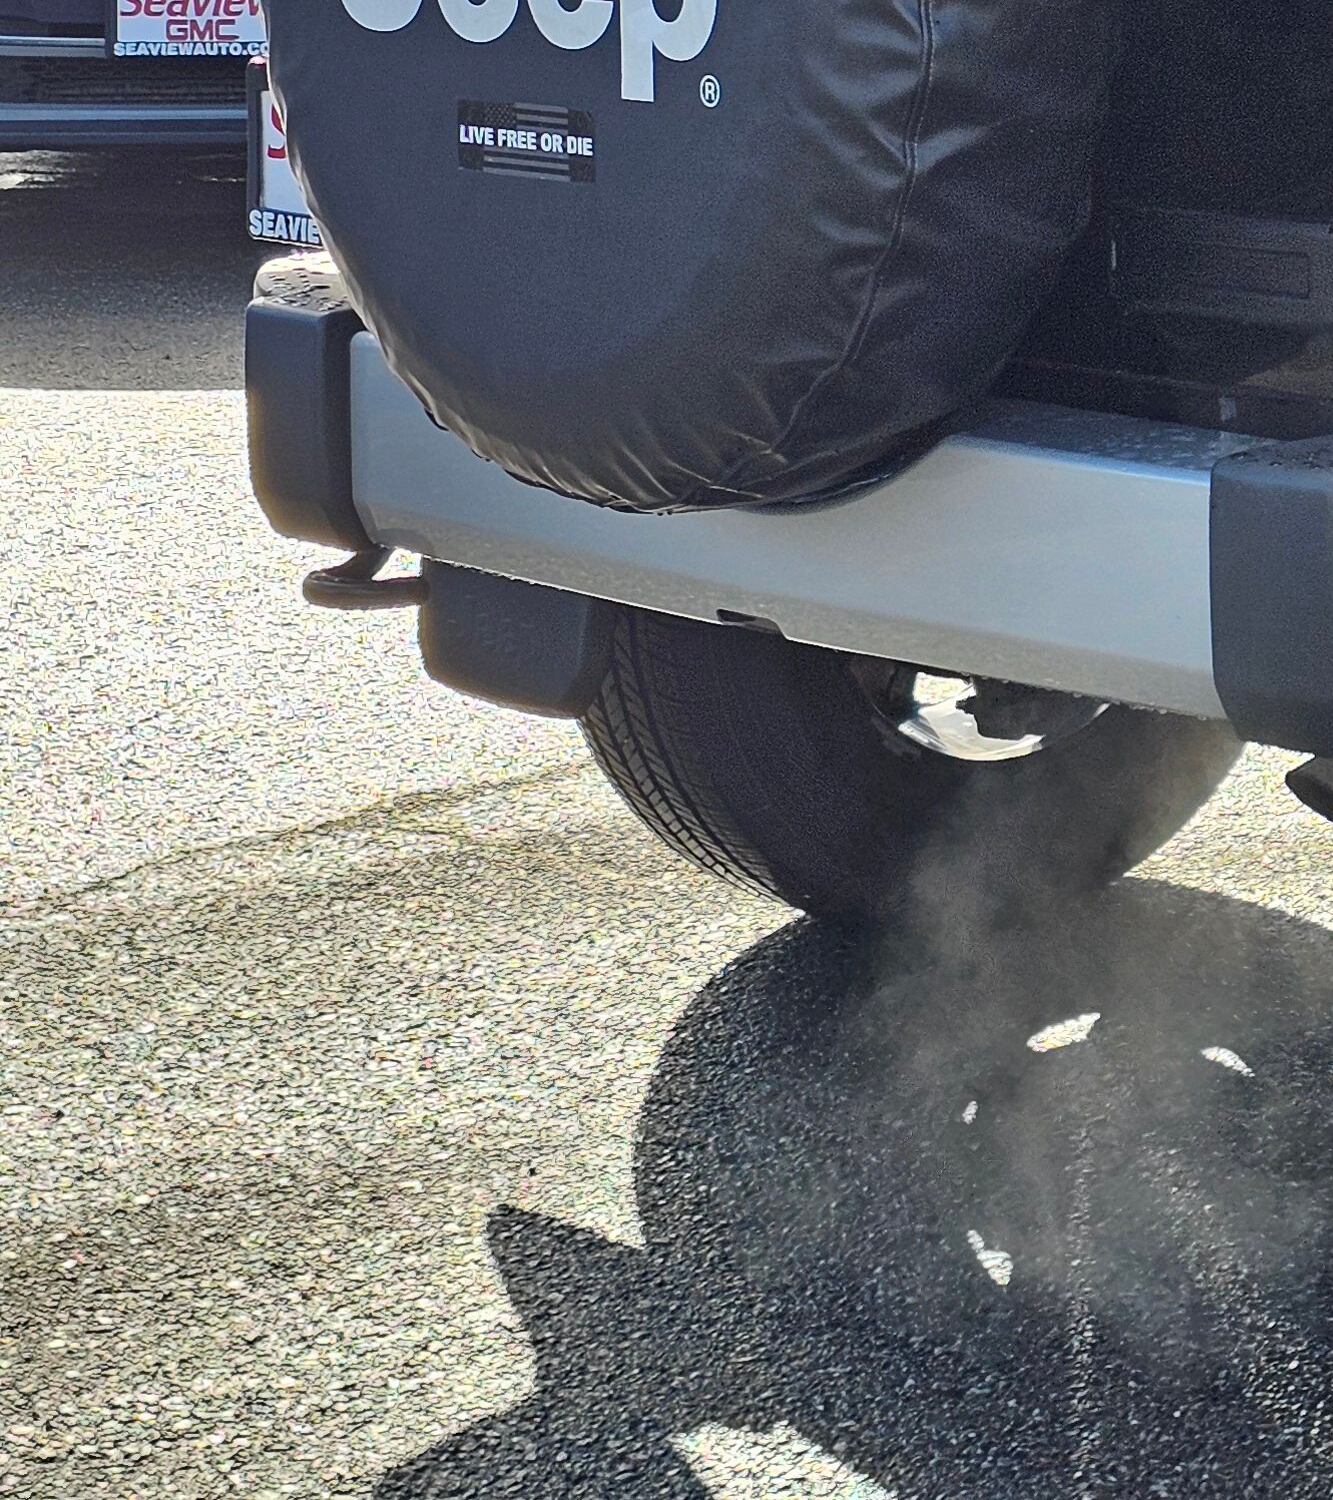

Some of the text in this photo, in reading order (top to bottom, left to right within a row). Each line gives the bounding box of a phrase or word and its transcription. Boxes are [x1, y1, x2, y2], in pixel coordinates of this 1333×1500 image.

[165, 18, 240, 41] GMC
[459, 124, 594, 156] LIVE FREE OR DIE
